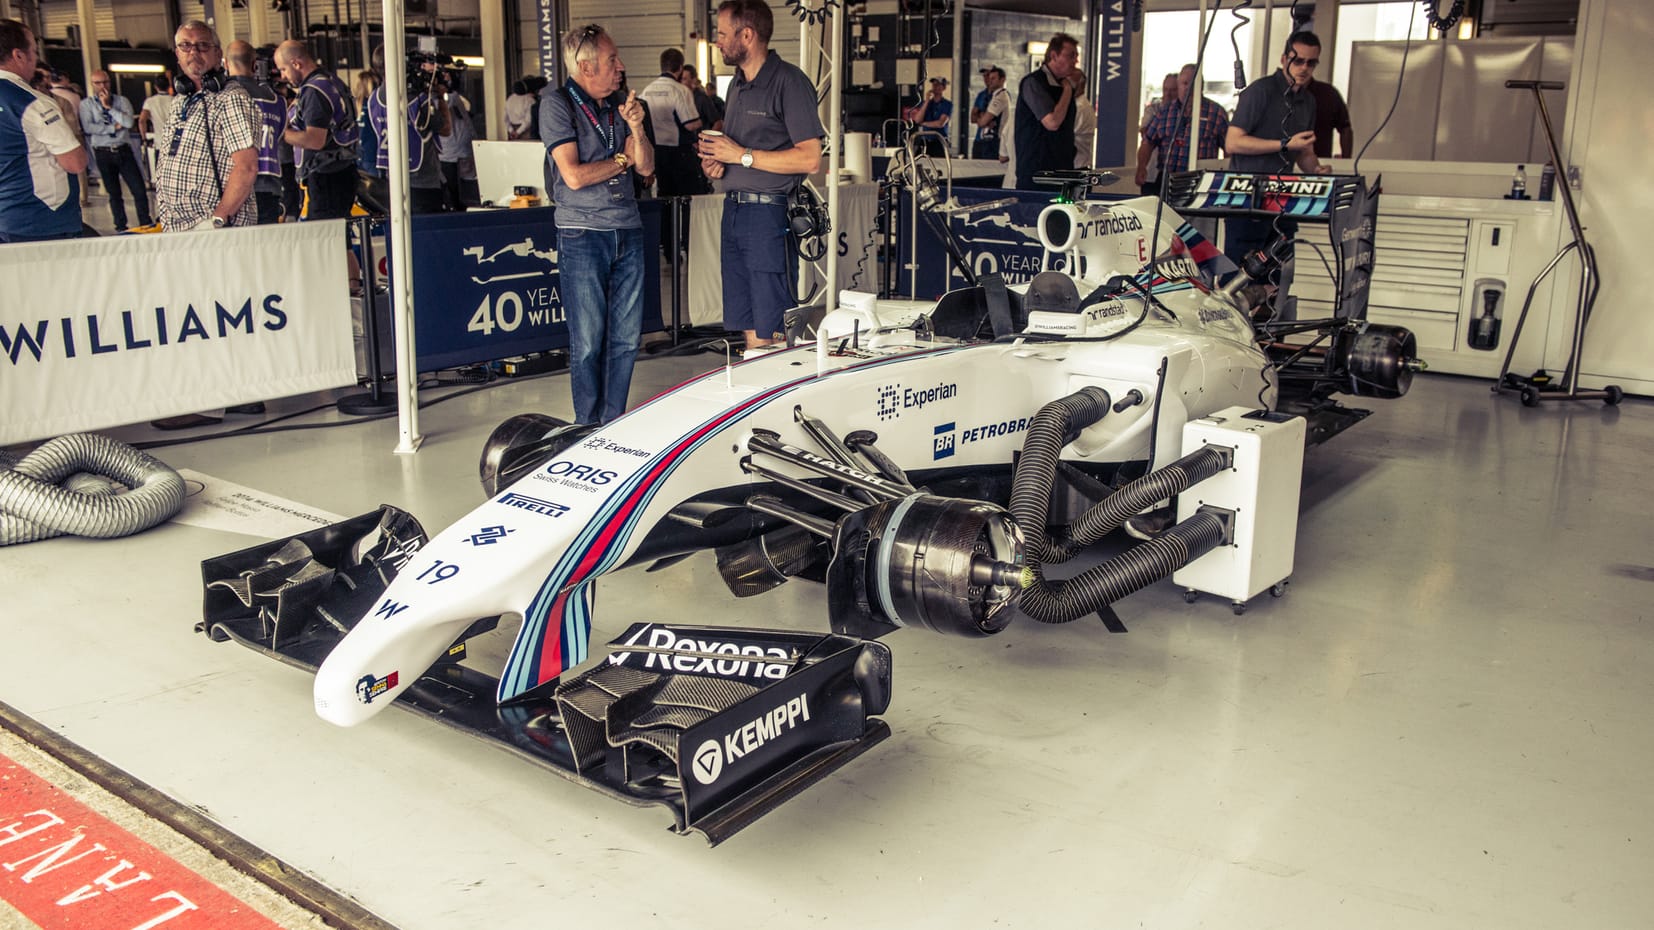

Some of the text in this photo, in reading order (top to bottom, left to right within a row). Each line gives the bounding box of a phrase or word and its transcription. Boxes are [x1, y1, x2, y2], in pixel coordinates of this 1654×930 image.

[541, 0, 553, 82] WILLIAMS
[1106, 0, 1124, 80] WILLIA
[1094, 211, 1143, 236] randstad
[1138, 238, 1147, 262] E
[1001, 254, 1041, 272] YEAR
[527, 287, 561, 306] YEA
[467, 291, 523, 335] 40
[528, 307, 568, 326] WILL
[1100, 303, 1124, 319] randstad
[0, 294, 288, 365] WILLIAMS
[903, 382, 957, 409] Experian
[961, 416, 1035, 444] PETROBRA
[604, 442, 651, 458] Experian
[935, 434, 954, 452] BR
[546, 461, 618, 485] ORIS
[803, 453, 883, 485] HATCH
[533, 473, 599, 494] Swiss Watches
[496, 492, 571, 518] PIRELLI
[416, 559, 460, 585] 19
[374, 599, 410, 620] W
[644, 629, 789, 679] Rexona
[724, 693, 810, 764] KEMPPI
